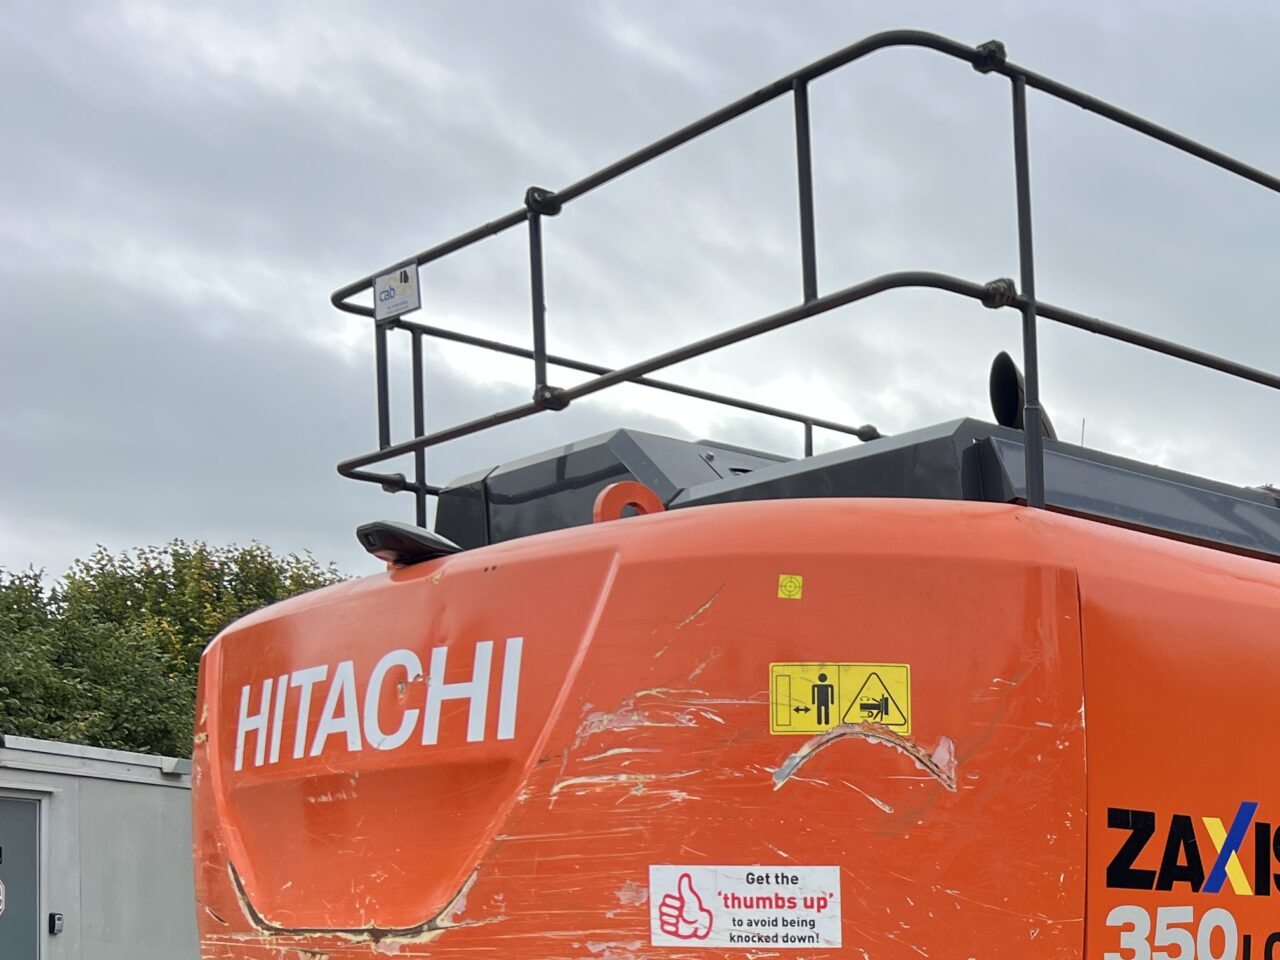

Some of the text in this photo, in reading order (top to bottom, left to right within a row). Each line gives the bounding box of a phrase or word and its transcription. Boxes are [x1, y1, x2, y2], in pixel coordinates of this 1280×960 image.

[234, 637, 524, 771] HITACHI
[746, 872, 799, 885] Get the
[732, 917, 816, 929] to avoid being
[729, 933, 820, 943] knocked down!
